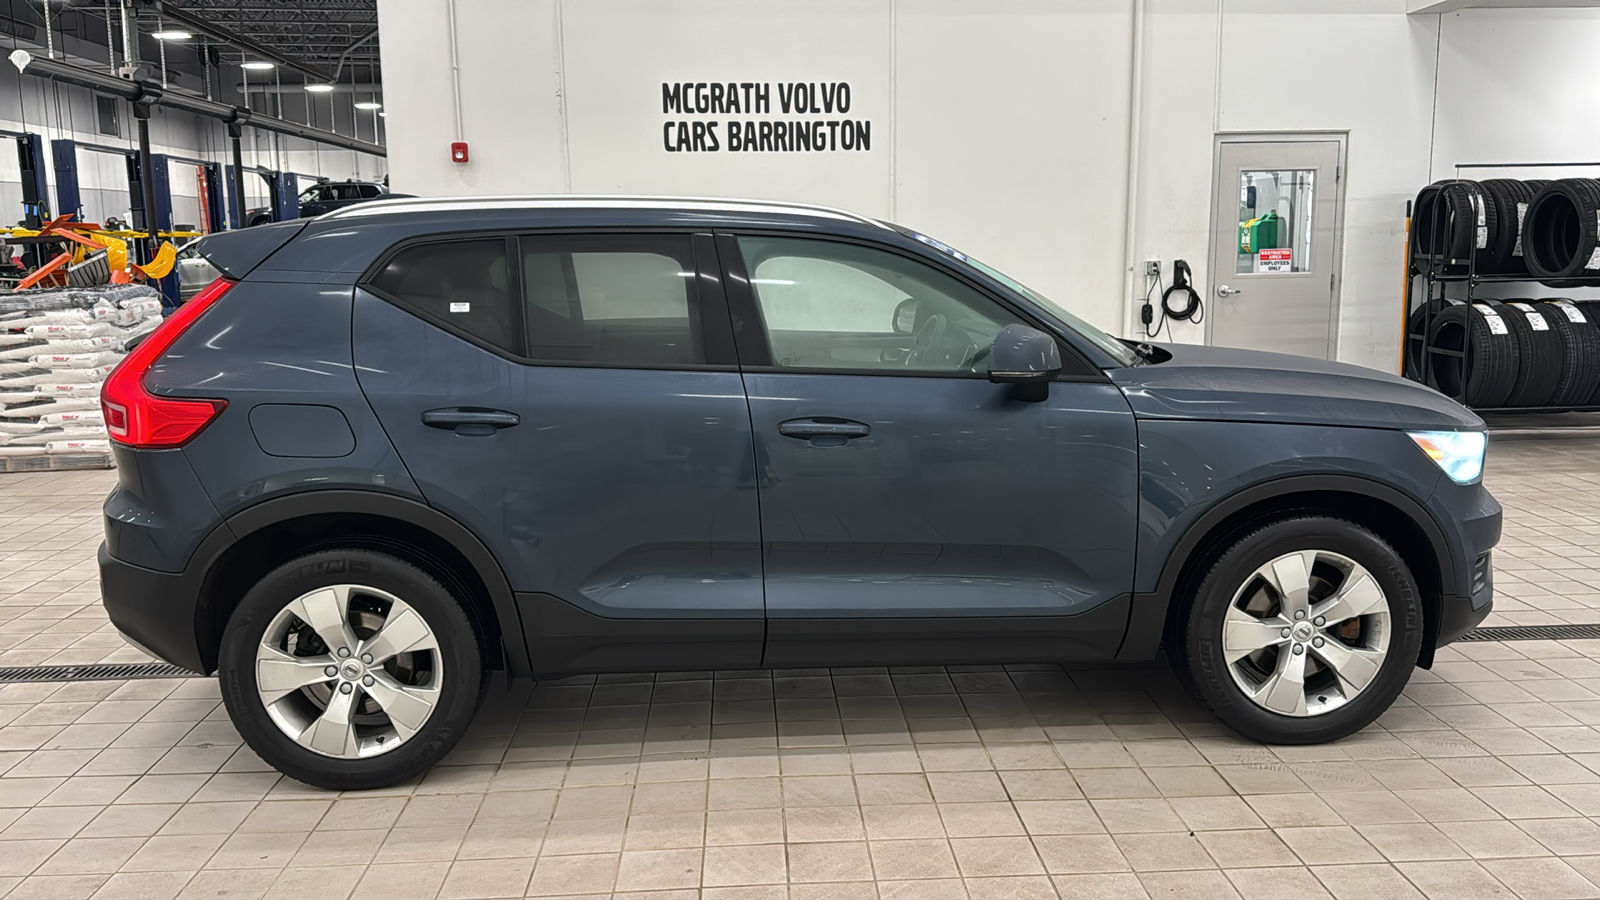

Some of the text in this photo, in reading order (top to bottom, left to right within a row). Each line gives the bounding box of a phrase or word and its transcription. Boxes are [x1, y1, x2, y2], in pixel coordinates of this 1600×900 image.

[662, 82, 851, 114] MCGRATH VOLVO
[663, 119, 871, 152] CARS BARRINGTON
